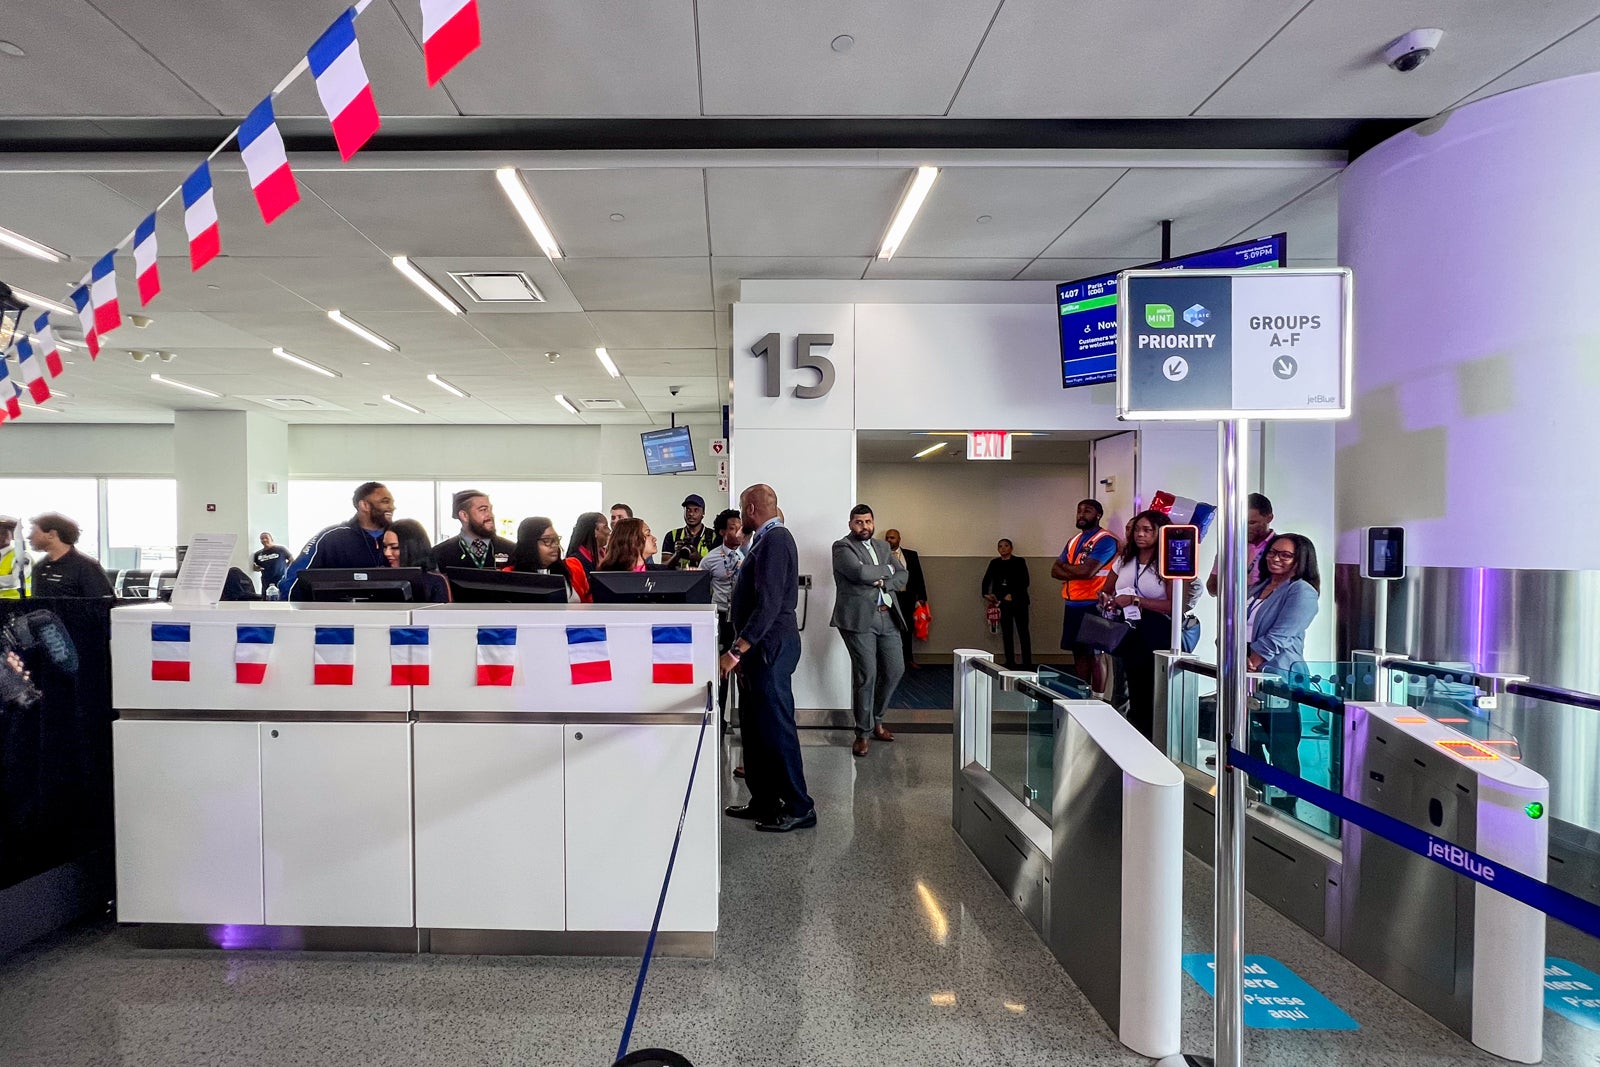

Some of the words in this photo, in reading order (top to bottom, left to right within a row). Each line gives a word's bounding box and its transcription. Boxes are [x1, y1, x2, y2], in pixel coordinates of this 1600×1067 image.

[1088, 282, 1103, 290] Paris
[1060, 289, 1079, 299] 1407
[1148, 314, 1172, 322] MINT
[1249, 315, 1321, 330] GROUPS
[1097, 321, 1117, 330] Now
[1079, 335, 1109, 345] Customers
[1089, 340, 1114, 348] welcome
[1138, 334, 1216, 349] PRIORITY
[1269, 332, 1301, 347] A-F
[751, 333, 835, 399] 15
[1306, 394, 1335, 405] jetBlue
[973, 431, 1006, 457] EXIT
[1427, 836, 1495, 881] jetBlue
[1244, 979, 1279, 989] ere
